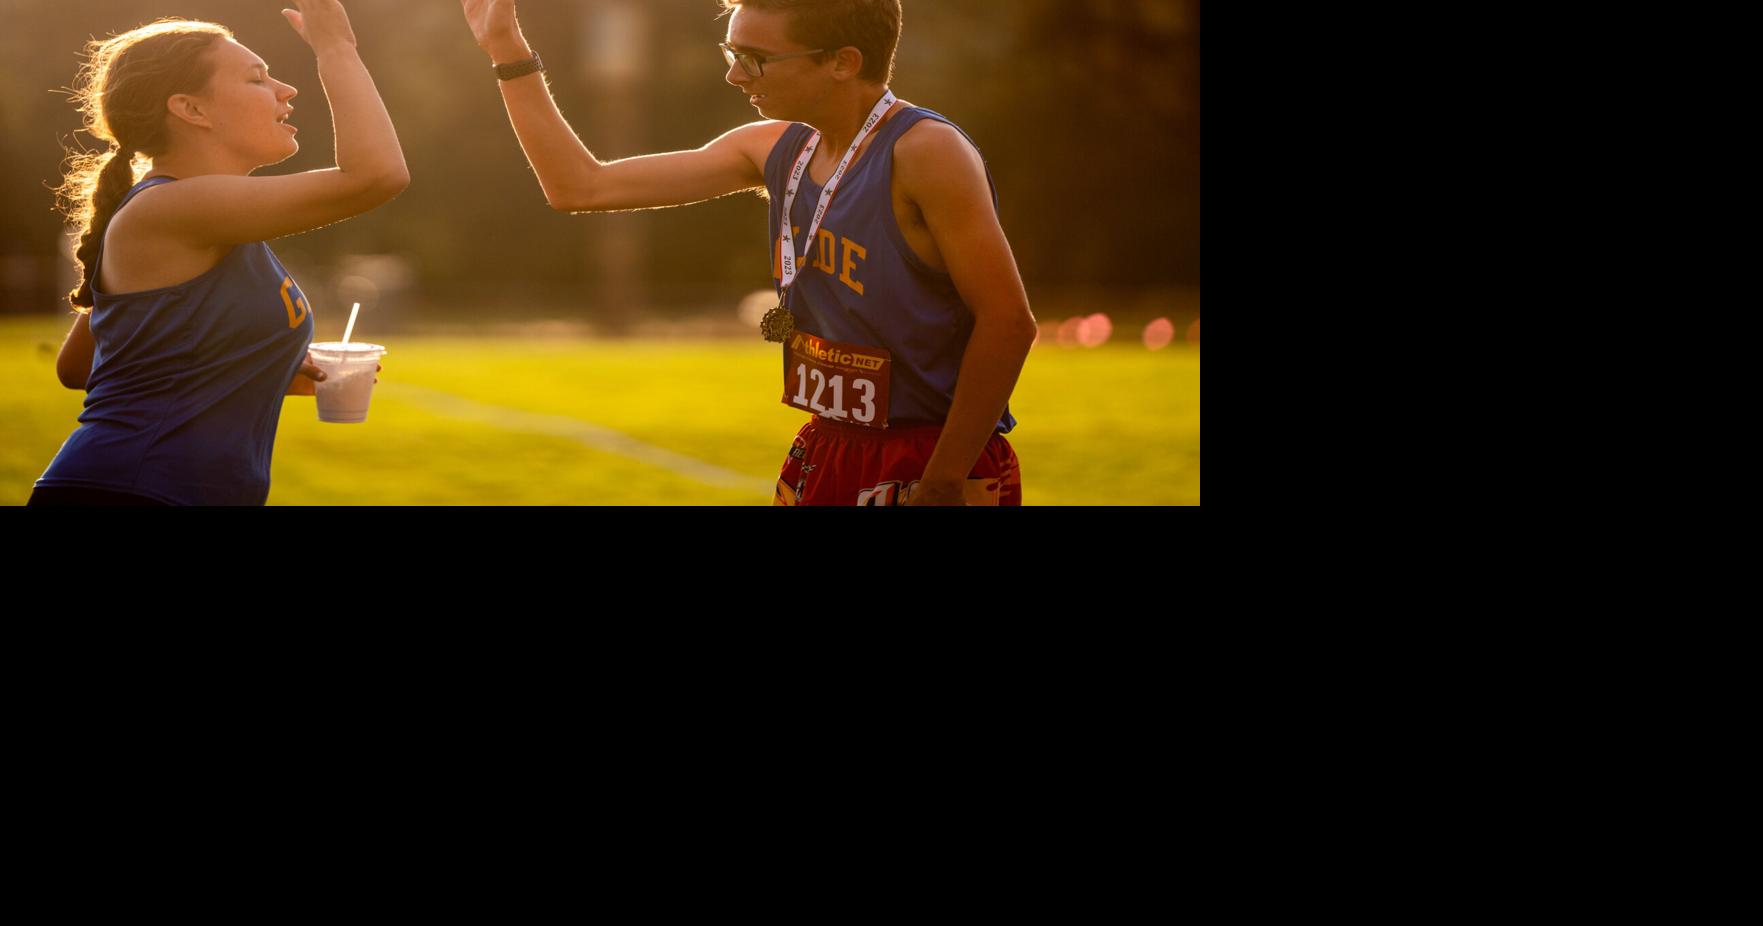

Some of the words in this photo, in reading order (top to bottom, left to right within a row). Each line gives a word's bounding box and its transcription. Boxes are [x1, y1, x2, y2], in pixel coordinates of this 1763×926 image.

[862, 113, 880, 134] 2023
[792, 160, 804, 181] 2023
[783, 255, 793, 276] 2023
[791, 334, 852, 366] Athletic
[855, 357, 880, 369] NET
[792, 362, 876, 423] 1213
